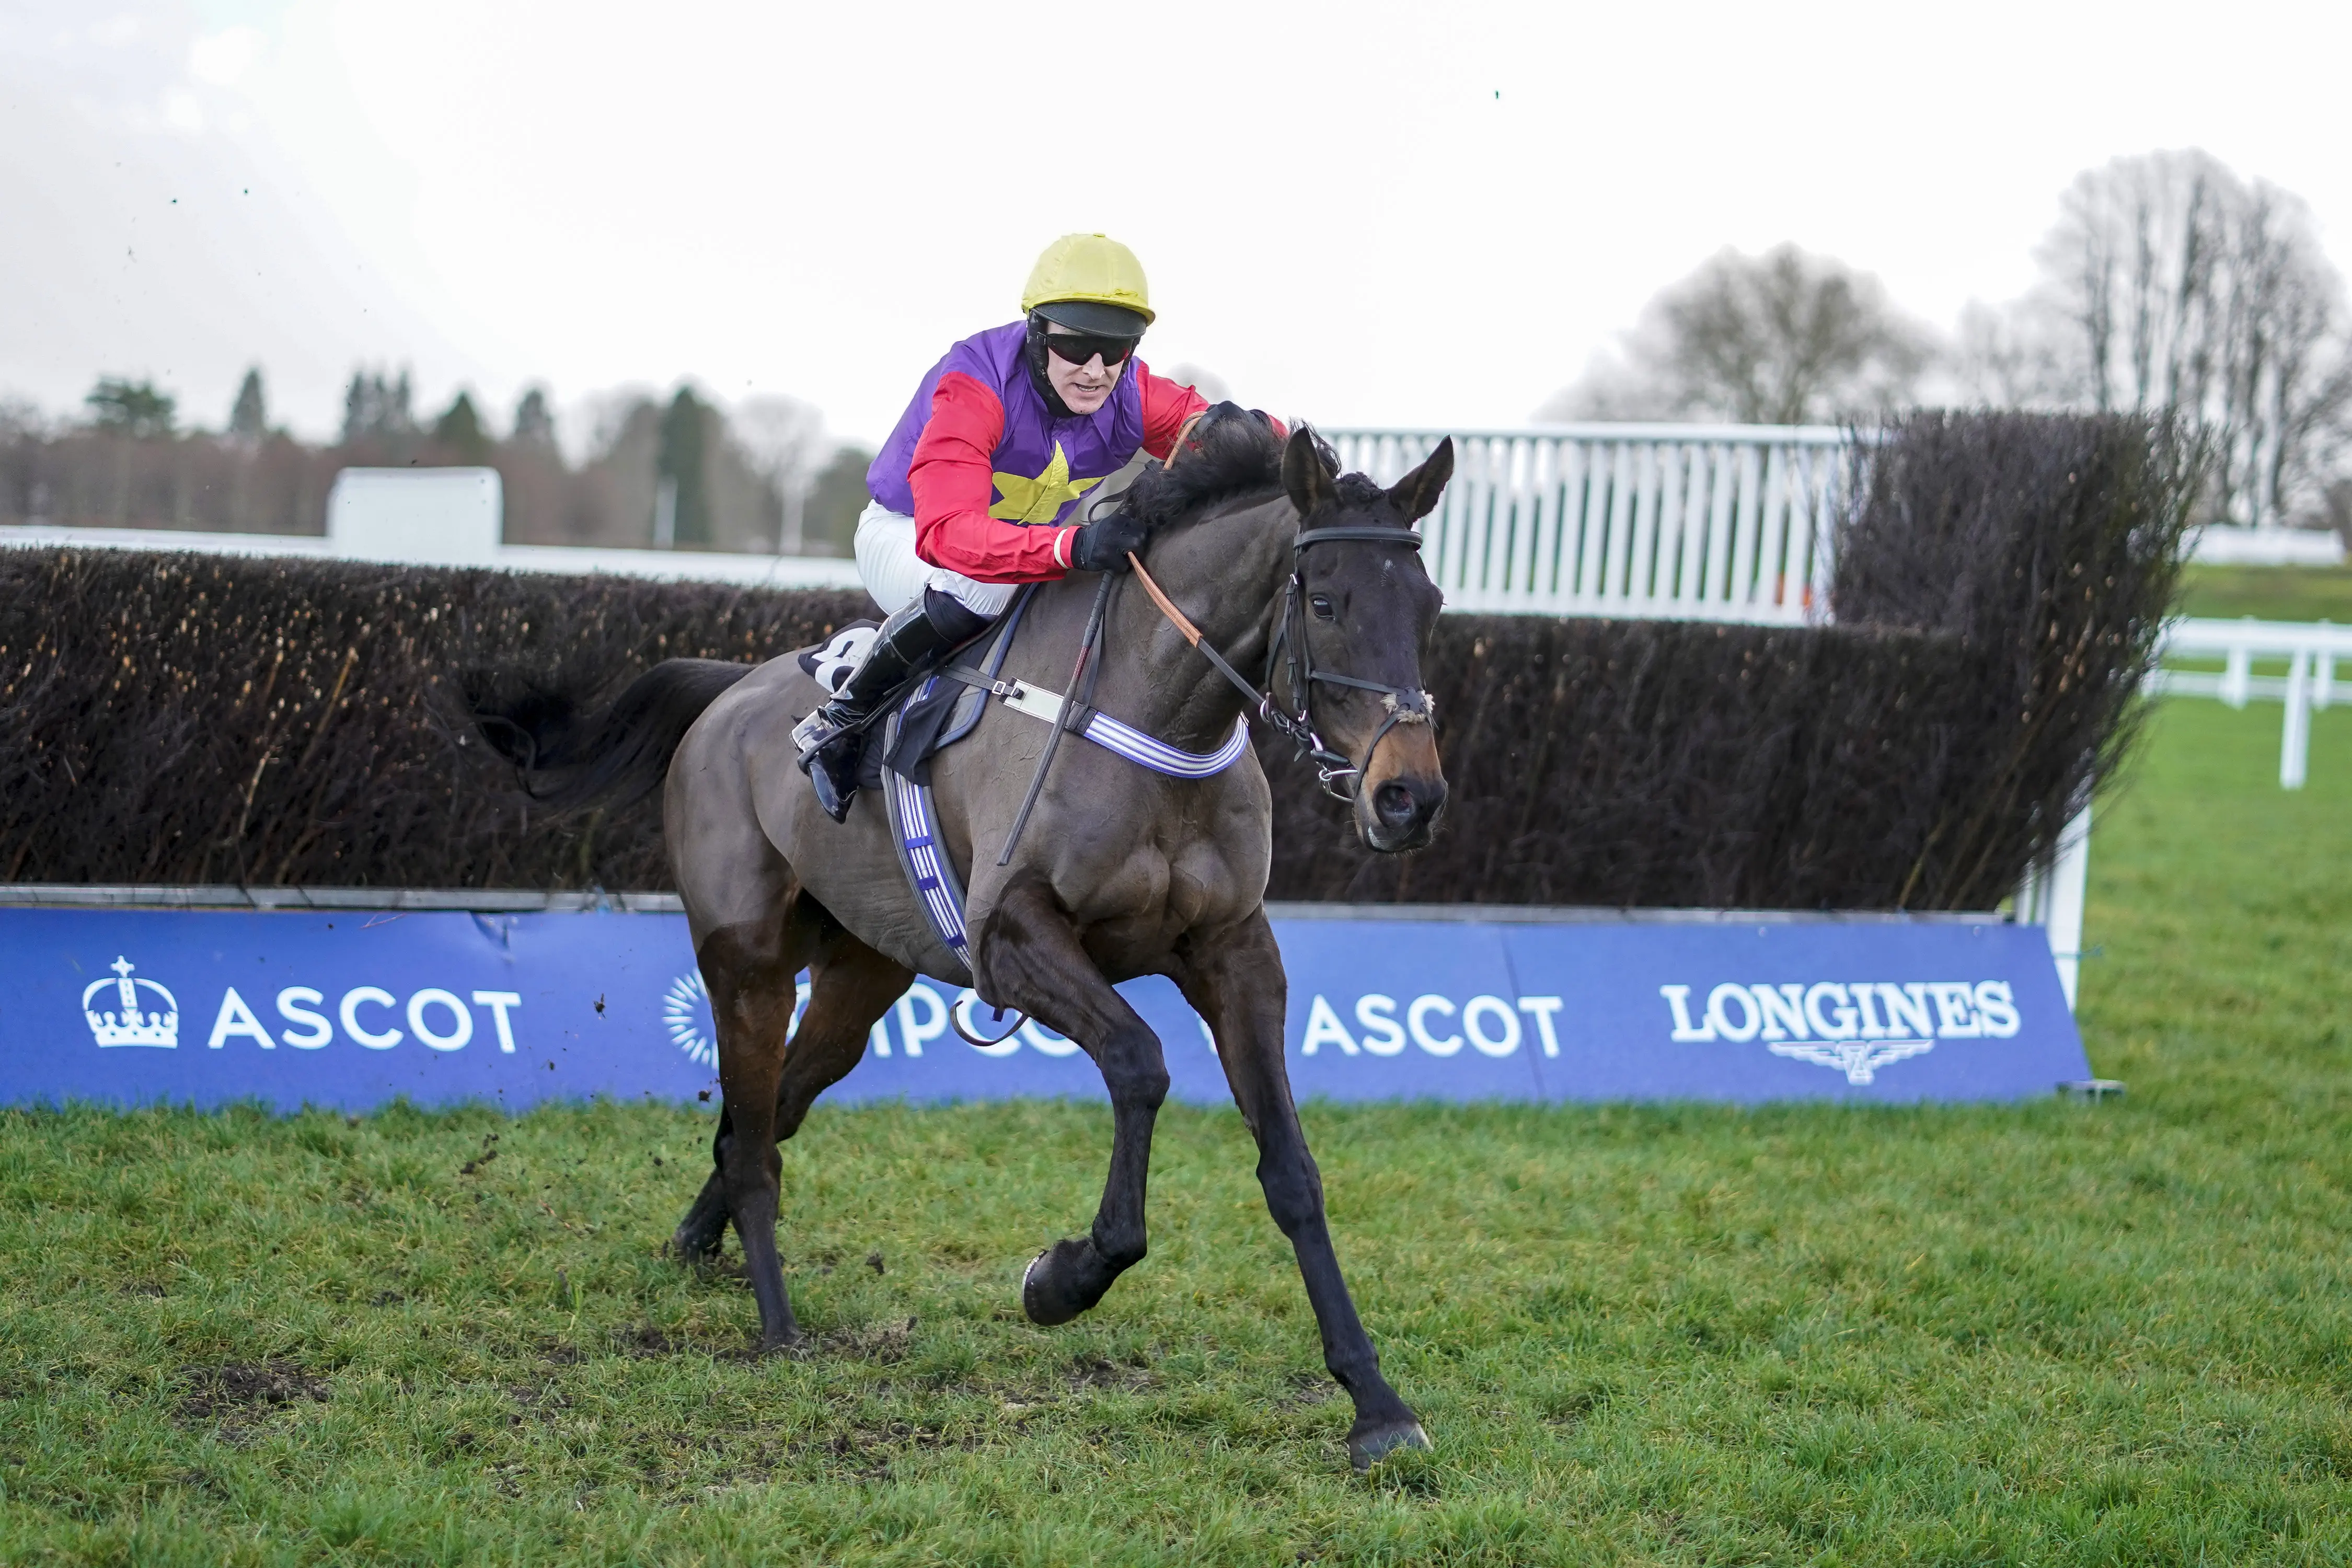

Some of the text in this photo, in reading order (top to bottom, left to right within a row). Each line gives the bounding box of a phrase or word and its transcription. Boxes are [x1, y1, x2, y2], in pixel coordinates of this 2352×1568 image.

[207, 986, 521, 1053] ASCOT
[1301, 994, 1563, 1058] ASCOT
[1659, 981, 2020, 1042] LONGINES
